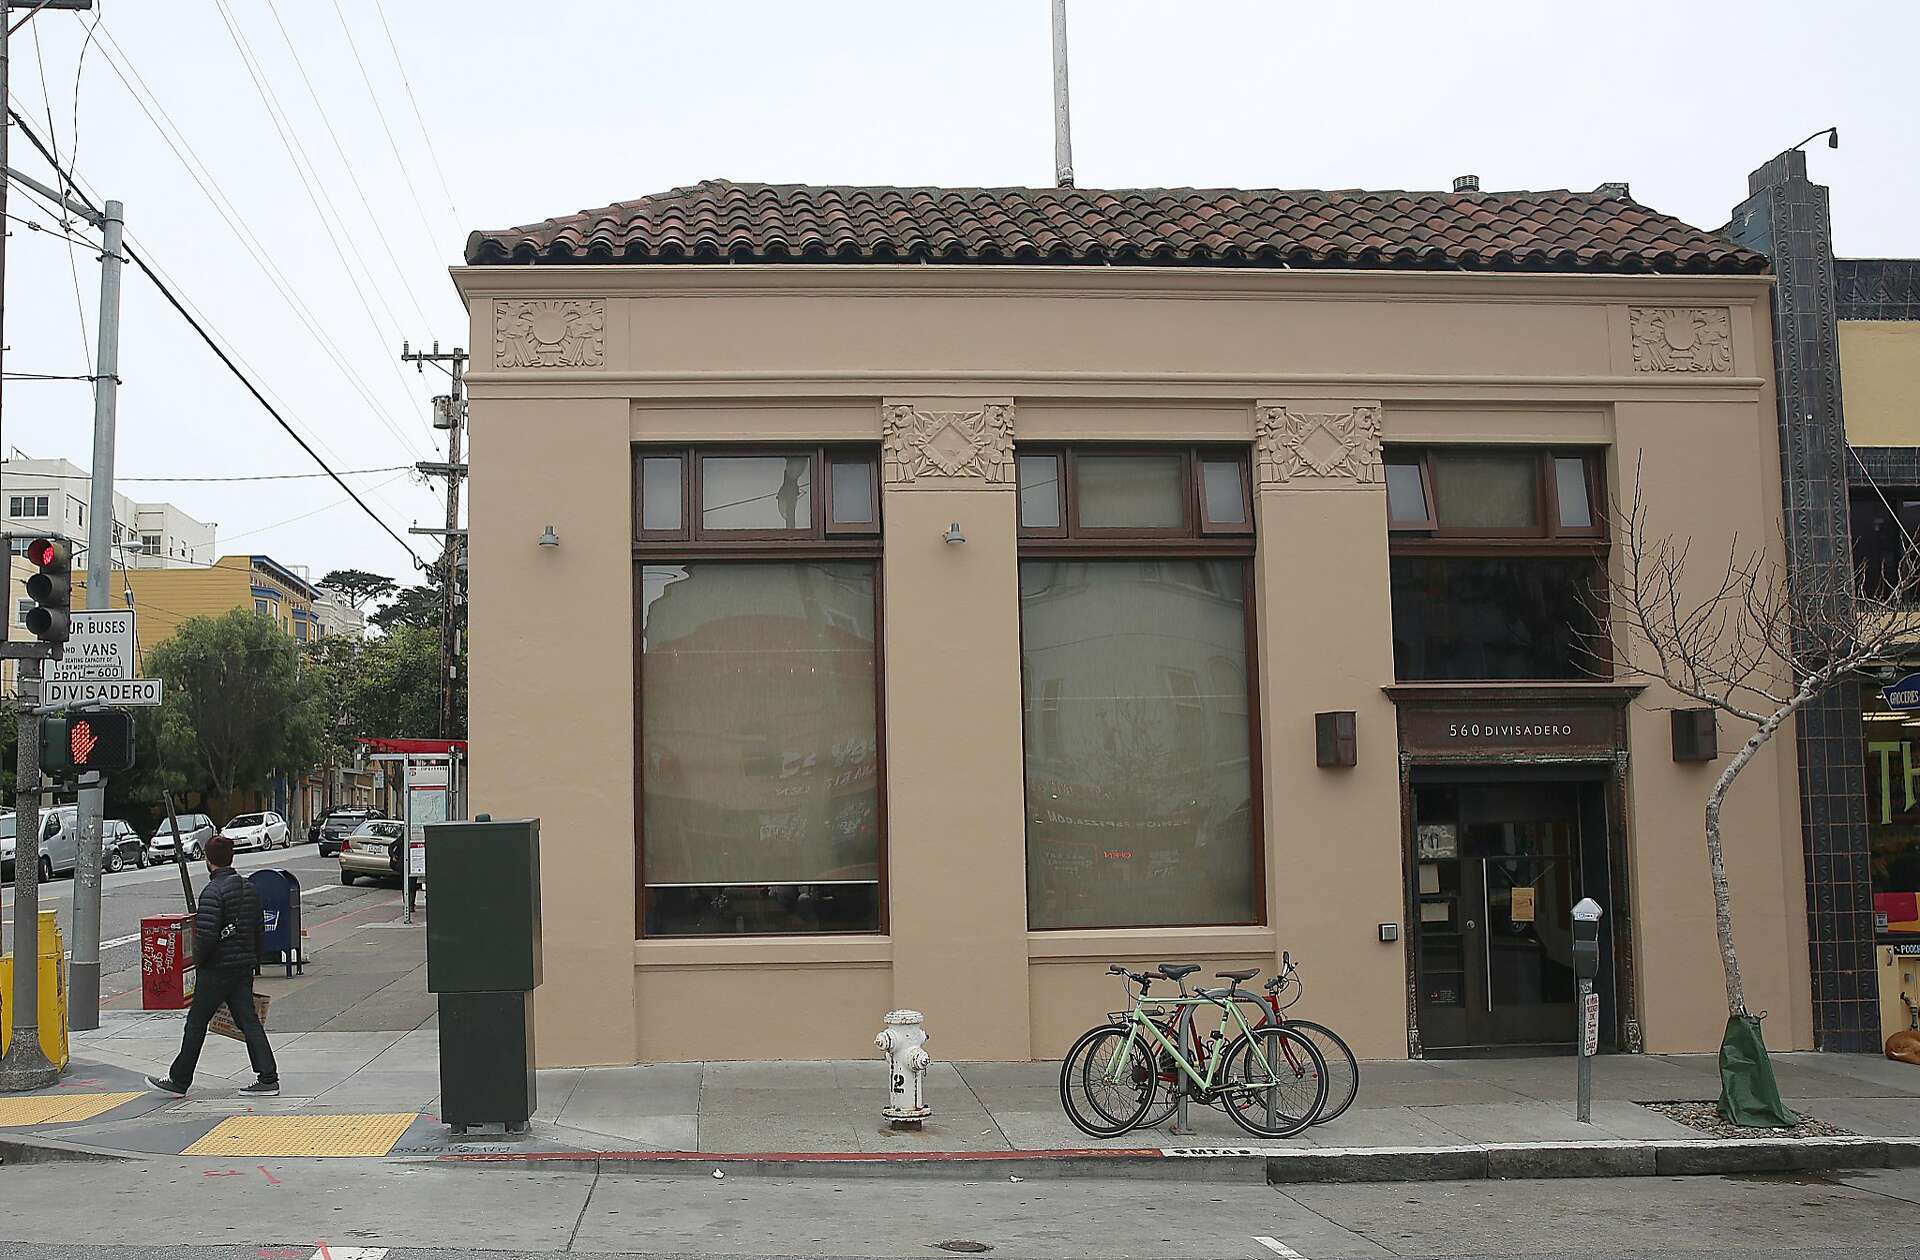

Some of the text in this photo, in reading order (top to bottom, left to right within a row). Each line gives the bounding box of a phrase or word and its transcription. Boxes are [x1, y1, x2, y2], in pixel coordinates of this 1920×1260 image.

[70, 620, 126, 635] UR BUSES
[82, 643, 118, 656] VANS
[97, 668, 119, 677] 600
[51, 685, 155, 700] DIVISADERO
[1890, 690, 1919, 705] GROCERIES
[1449, 724, 1572, 736] 560 DIVISADERO
